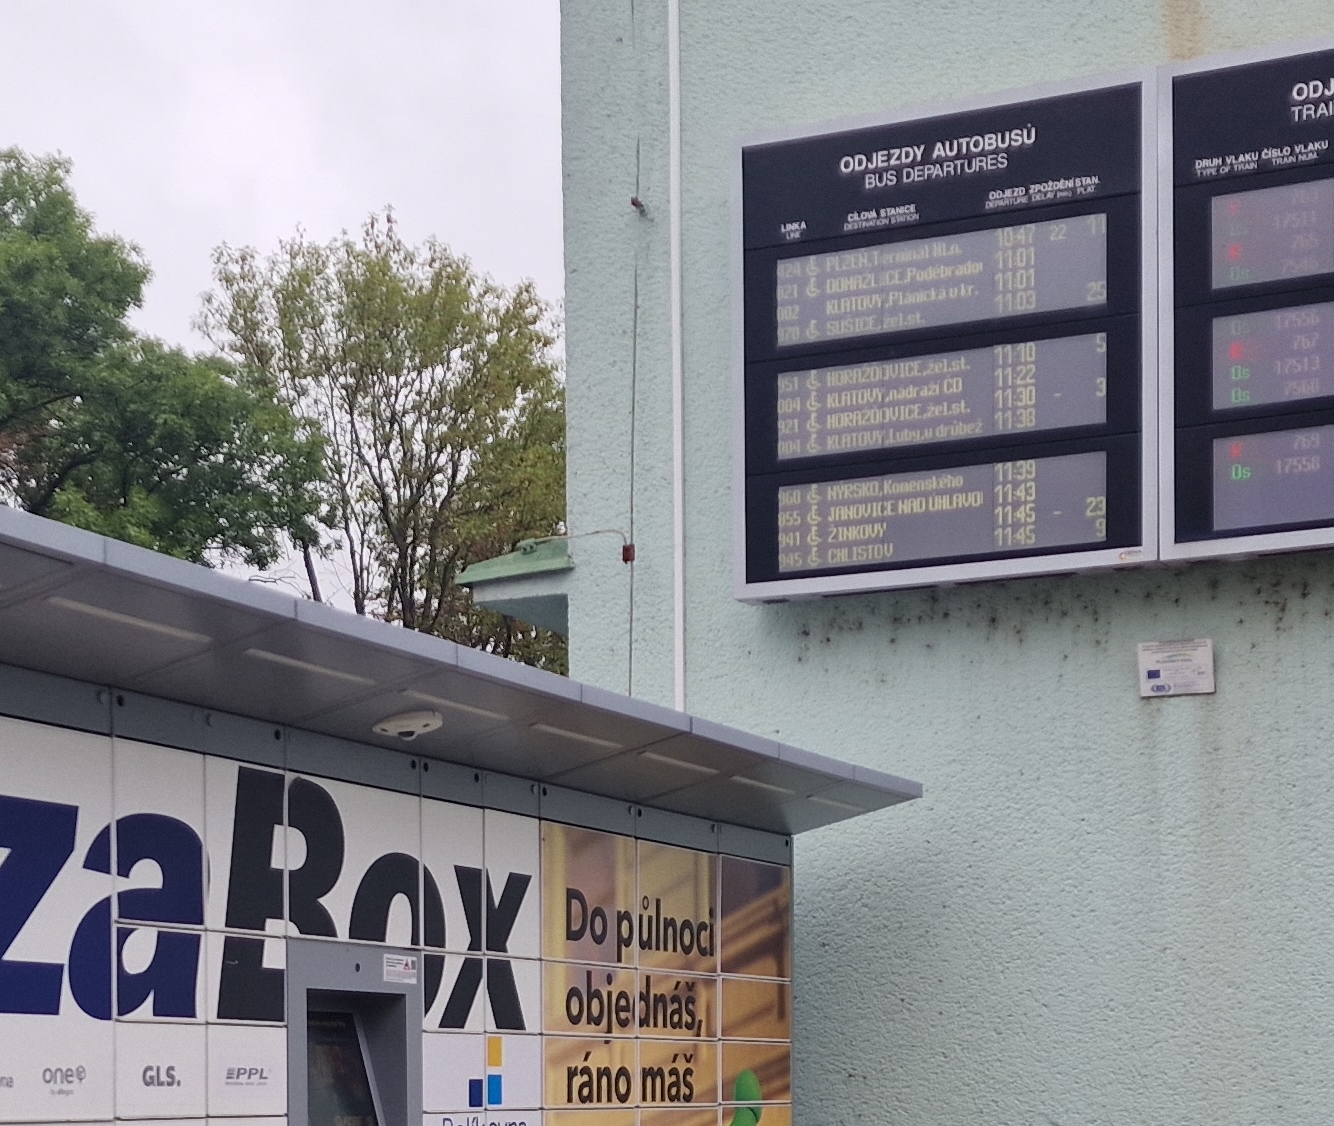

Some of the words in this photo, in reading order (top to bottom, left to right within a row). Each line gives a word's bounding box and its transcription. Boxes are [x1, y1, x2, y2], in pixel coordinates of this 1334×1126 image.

[840, 144, 925, 173] ODJEZDY
[932, 123, 1037, 159] AUTOBUSŮ
[1195, 156, 1222, 170] DRUH
[1225, 151, 1259, 166] VLAKU
[1262, 144, 1290, 160] ČÍSLO
[1294, 139, 1329, 155] VLAKU
[865, 170, 898, 189] BUS
[903, 153, 1008, 184] DEPARTURES
[1196, 166, 1219, 178] TYPE
[1221, 164, 1233, 175] OF
[1234, 161, 1258, 173] TRAIN
[1272, 155, 1295, 167] TRAIN
[985, 195, 1028, 209] DEPARTURE
[1031, 189, 1055, 202] DELAY
[988, 187, 1026, 200] ODJEZD
[1029, 177, 1074, 194] ZPOŽDĚNÍ
[1075, 175, 1101, 187] STAN.
[843, 216, 889, 231] DESTINATION
[890, 212, 920, 226] STATION
[847, 208, 877, 222] CÍLOVÁ
[880, 204, 916, 218] STANICE
[780, 219, 807, 233] LINKA
[785, 231, 802, 240] LINE
[995, 224, 1036, 248] 10:47
[1050, 223, 1067, 241] 22
[995, 246, 1036, 269] 11:01
[995, 268, 1036, 291] 11:01
[995, 290, 1036, 313] 11:03
[994, 342, 1036, 366] 11:10
[1095, 333, 1106, 353] 5
[994, 364, 1036, 387] 11:22
[994, 386, 1036, 409] 11:30
[994, 408, 1036, 431] 11:38
[994, 460, 1036, 483] 11:39
[828, 500, 896, 522] JANOVICE
[898, 496, 926, 515] NAD
[994, 481, 1036, 503] 11:43
[828, 522, 886, 543] ŽINKOVY
[994, 503, 1036, 526] 11:45
[828, 543, 894, 564] CHLISTOV
[994, 524, 1036, 547] 11:45
[566, 887, 608, 945] Do
[616, 895, 715, 963] půlnoci
[565, 970, 704, 1044] objednáš,
[142, 1065, 181, 1088] GLS.
[566, 1051, 632, 1104] ráno
[641, 1053, 694, 1103] máš
